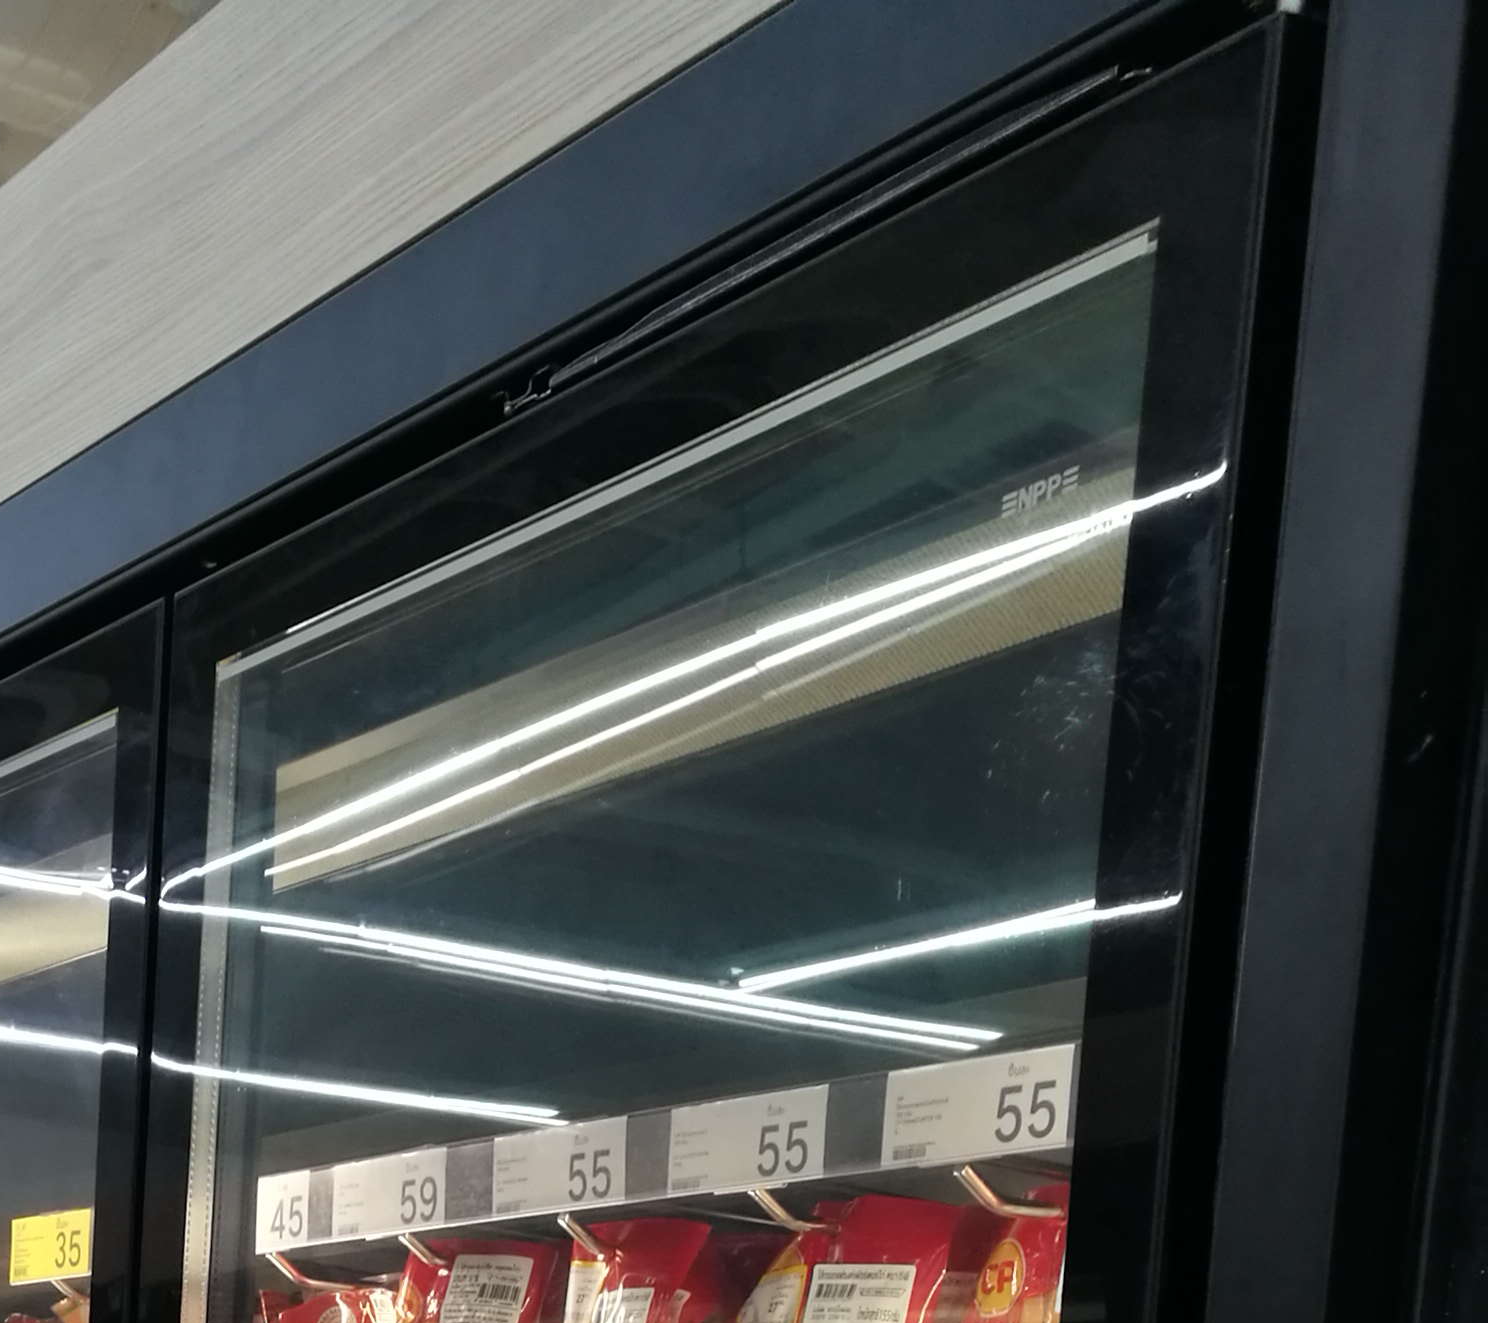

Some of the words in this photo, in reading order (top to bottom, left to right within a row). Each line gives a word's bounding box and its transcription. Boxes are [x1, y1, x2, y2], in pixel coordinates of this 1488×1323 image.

[995, 1080, 1057, 1143] 55
[757, 1120, 809, 1177] 55
[568, 1149, 612, 1201] 55
[269, 1194, 304, 1240] 45
[400, 1177, 438, 1225] 59
[55, 1230, 82, 1269] 35
[979, 1260, 1016, 1295] CP
